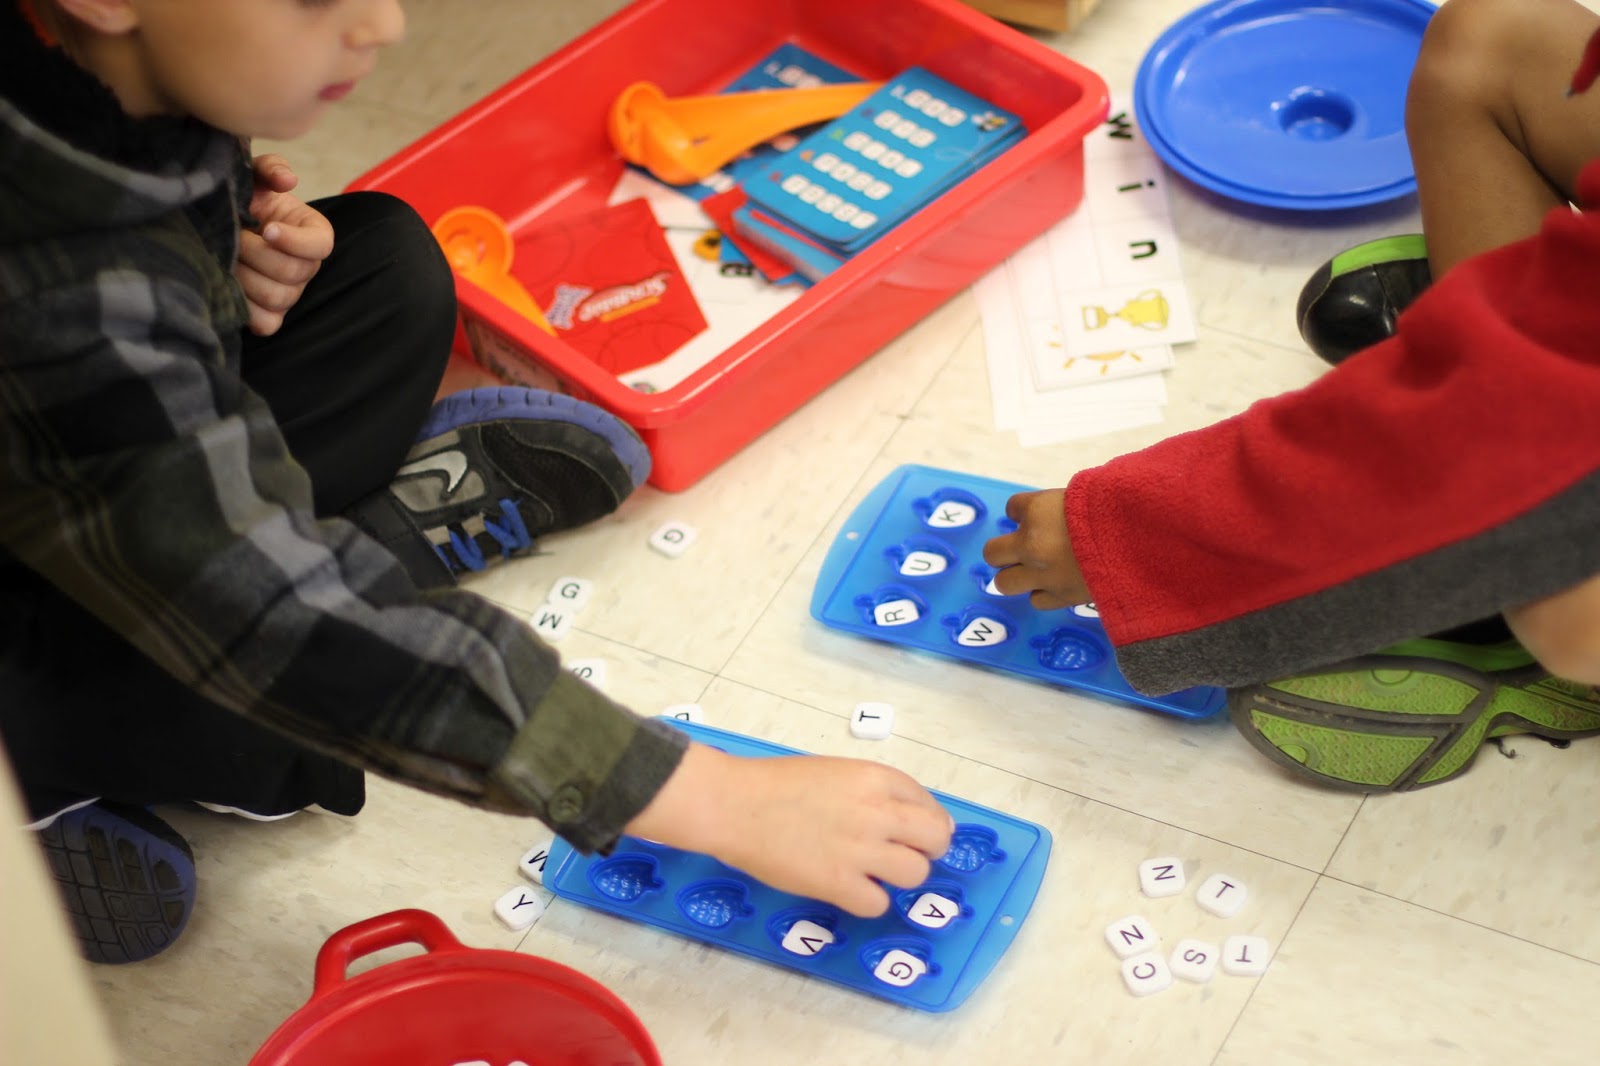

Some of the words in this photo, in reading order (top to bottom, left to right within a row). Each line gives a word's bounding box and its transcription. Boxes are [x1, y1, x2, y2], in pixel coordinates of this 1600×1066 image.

[937, 507, 962, 524] K
[663, 527, 685, 545] G
[909, 558, 932, 573] U
[560, 582, 581, 600] G
[884, 608, 907, 624] R
[858, 710, 881, 722] T
[1215, 880, 1235, 899] T
[512, 893, 534, 911] Y
[922, 903, 946, 919] A
[799, 936, 824, 953] V
[1183, 949, 1207, 965] S
[1235, 945, 1252, 963] T
[887, 961, 913, 980] G
[1132, 961, 1157, 980] C
